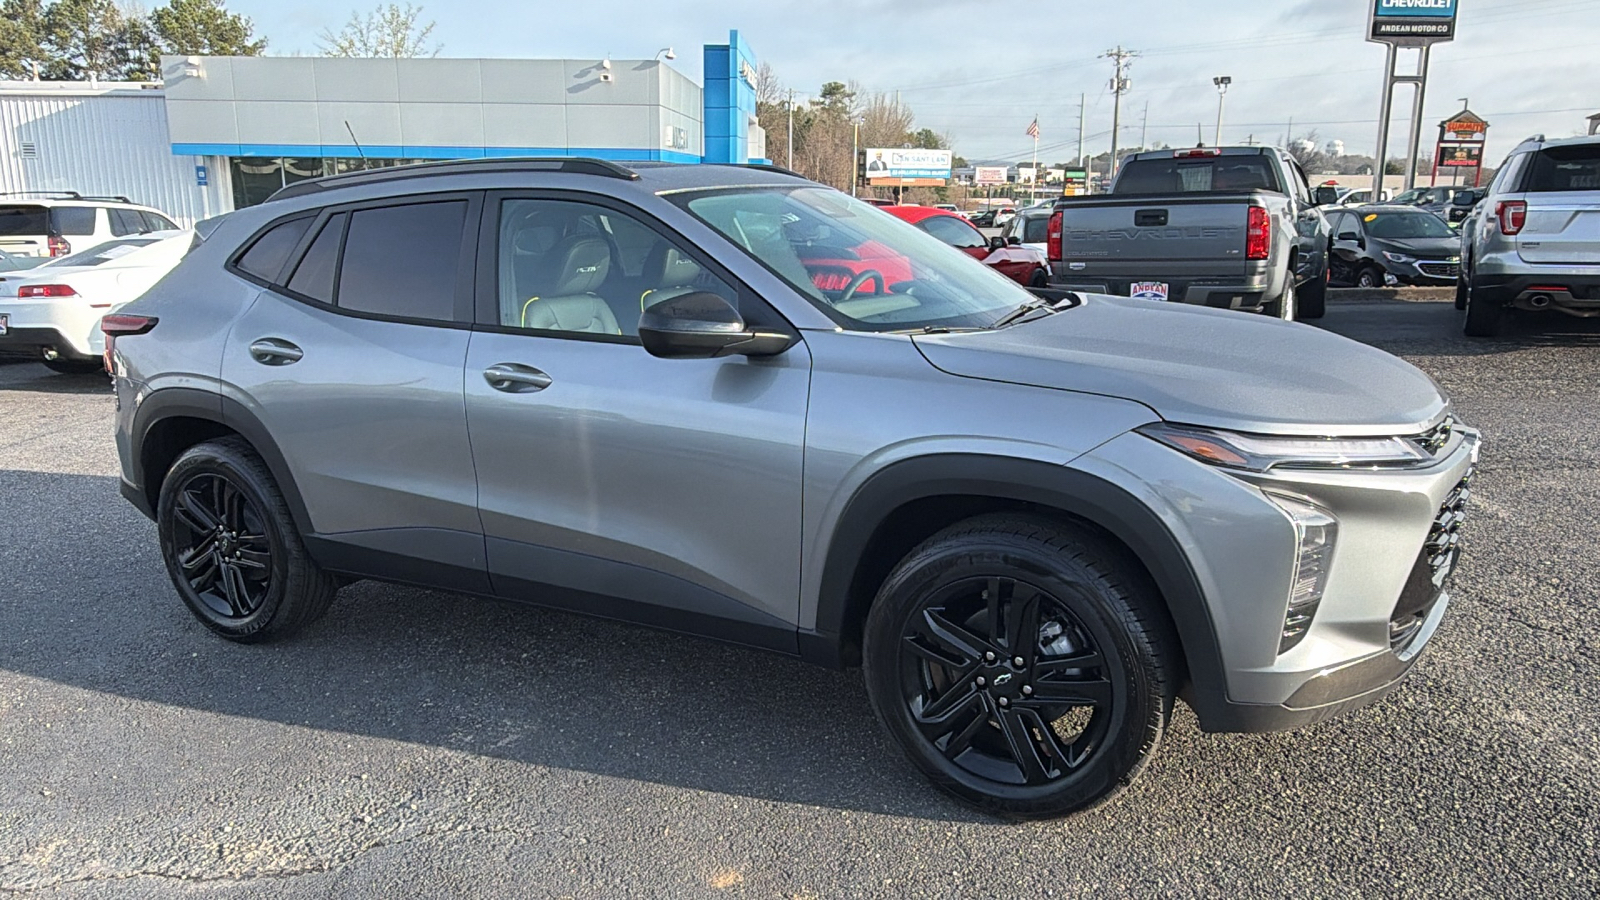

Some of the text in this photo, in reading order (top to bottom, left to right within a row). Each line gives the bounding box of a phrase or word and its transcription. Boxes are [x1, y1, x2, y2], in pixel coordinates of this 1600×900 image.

[1380, 24, 1448, 32] ANDEAN MOTOR CO
[1068, 227, 1240, 242] CHEVROLET
[1132, 284, 1168, 295] ANDEAN
